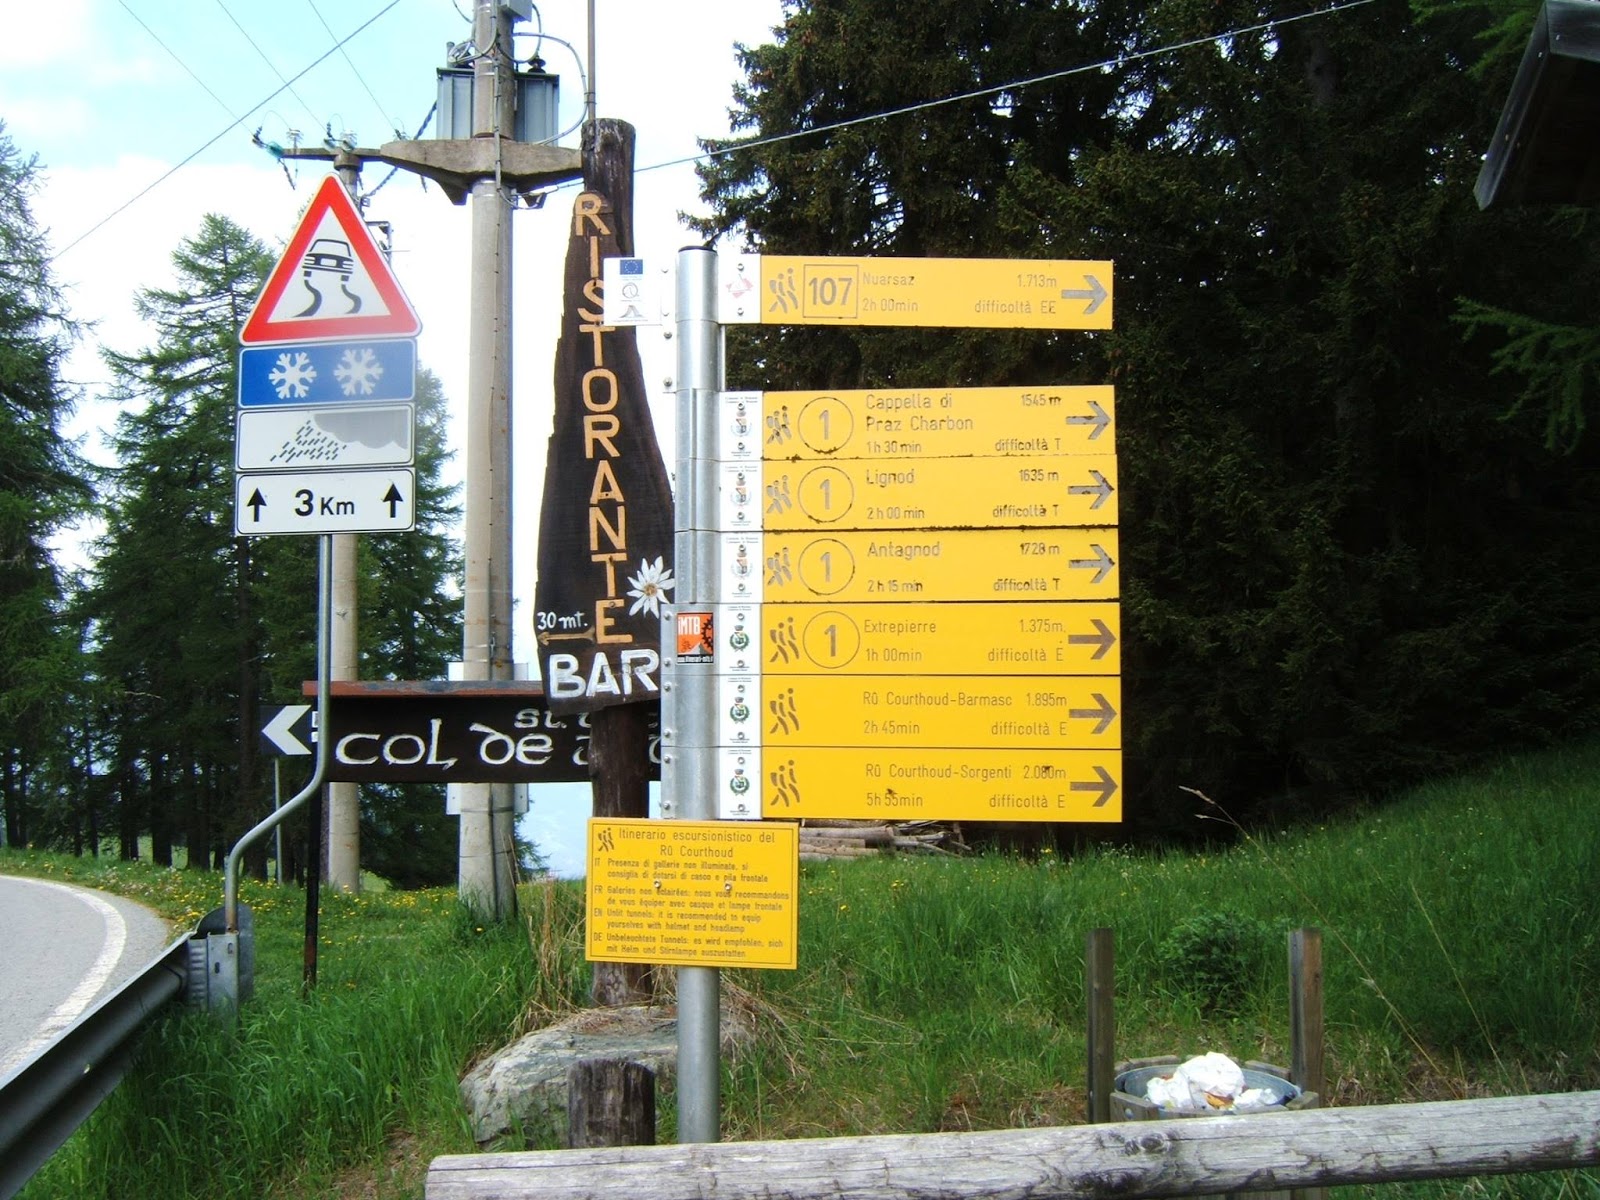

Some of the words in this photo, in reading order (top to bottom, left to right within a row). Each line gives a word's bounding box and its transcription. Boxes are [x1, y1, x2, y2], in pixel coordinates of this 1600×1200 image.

[863, 272, 914, 286] Nuarsaz
[1017, 274, 1057, 287] 1.713m
[808, 277, 852, 306] 107
[975, 299, 1032, 314] difficoltà
[1040, 300, 1056, 314] EE
[866, 394, 932, 412] Cappella
[940, 393, 952, 408] di
[1021, 394, 1047, 406] 1545
[1049, 396, 1061, 406] m
[575, 193, 632, 644] RISTORANTE
[818, 409, 830, 440] 1
[867, 416, 902, 432] Praz
[910, 416, 973, 431] Charbon
[884, 441, 897, 453] 30
[900, 441, 922, 453] min
[995, 438, 1048, 451] difficoltà
[1054, 438, 1061, 450] T
[866, 468, 915, 488] Lignod
[1019, 469, 1044, 481] 1635
[1048, 472, 1059, 481] m
[818, 479, 830, 510] 1
[294, 489, 314, 517] 3
[320, 497, 355, 516] Km
[887, 507, 900, 519] 00
[904, 505, 925, 519] min
[993, 505, 1046, 517] difficoltà
[1053, 504, 1060, 516] T
[868, 541, 941, 561] Antagnod
[1020, 543, 1046, 555] 1728
[1048, 545, 1061, 555] m
[819, 552, 831, 583] 1
[888, 580, 899, 592] 15
[902, 580, 923, 592] min
[994, 579, 1047, 592] difficoltà
[1052, 578, 1060, 591] T
[537, 611, 556, 630] 30
[558, 611, 588, 629] mt.
[864, 619, 936, 636] Extrepierre
[823, 625, 837, 657] 1
[866, 648, 878, 662] 1h
[883, 648, 922, 662] 00min
[988, 648, 1047, 662] difficoltà
[1056, 648, 1063, 662] E
[549, 648, 660, 699] BAR
[886, 692, 1012, 706] Courthoud-Barmasc
[1026, 693, 1067, 706] 1.895m
[864, 720, 878, 734] 2h
[882, 720, 920, 735] 45min
[991, 721, 1050, 735] difficoltà
[1060, 722, 1067, 735] E
[889, 764, 1012, 782] Courthoud-Sorgenti
[1023, 765, 1067, 779] 2.080m
[989, 794, 1048, 808] difficoltà
[1058, 795, 1066, 808] E
[619, 828, 666, 840] Itinerario
[673, 831, 752, 843] escursionistico
[759, 832, 775, 843] del
[680, 846, 734, 858] Courthoud
[607, 858, 640, 867] Presenza
[643, 859, 649, 867] di
[643, 871, 649, 879] di
[680, 872, 687, 880] di
[594, 885, 603, 894] FR
[594, 932, 602, 941] DE
